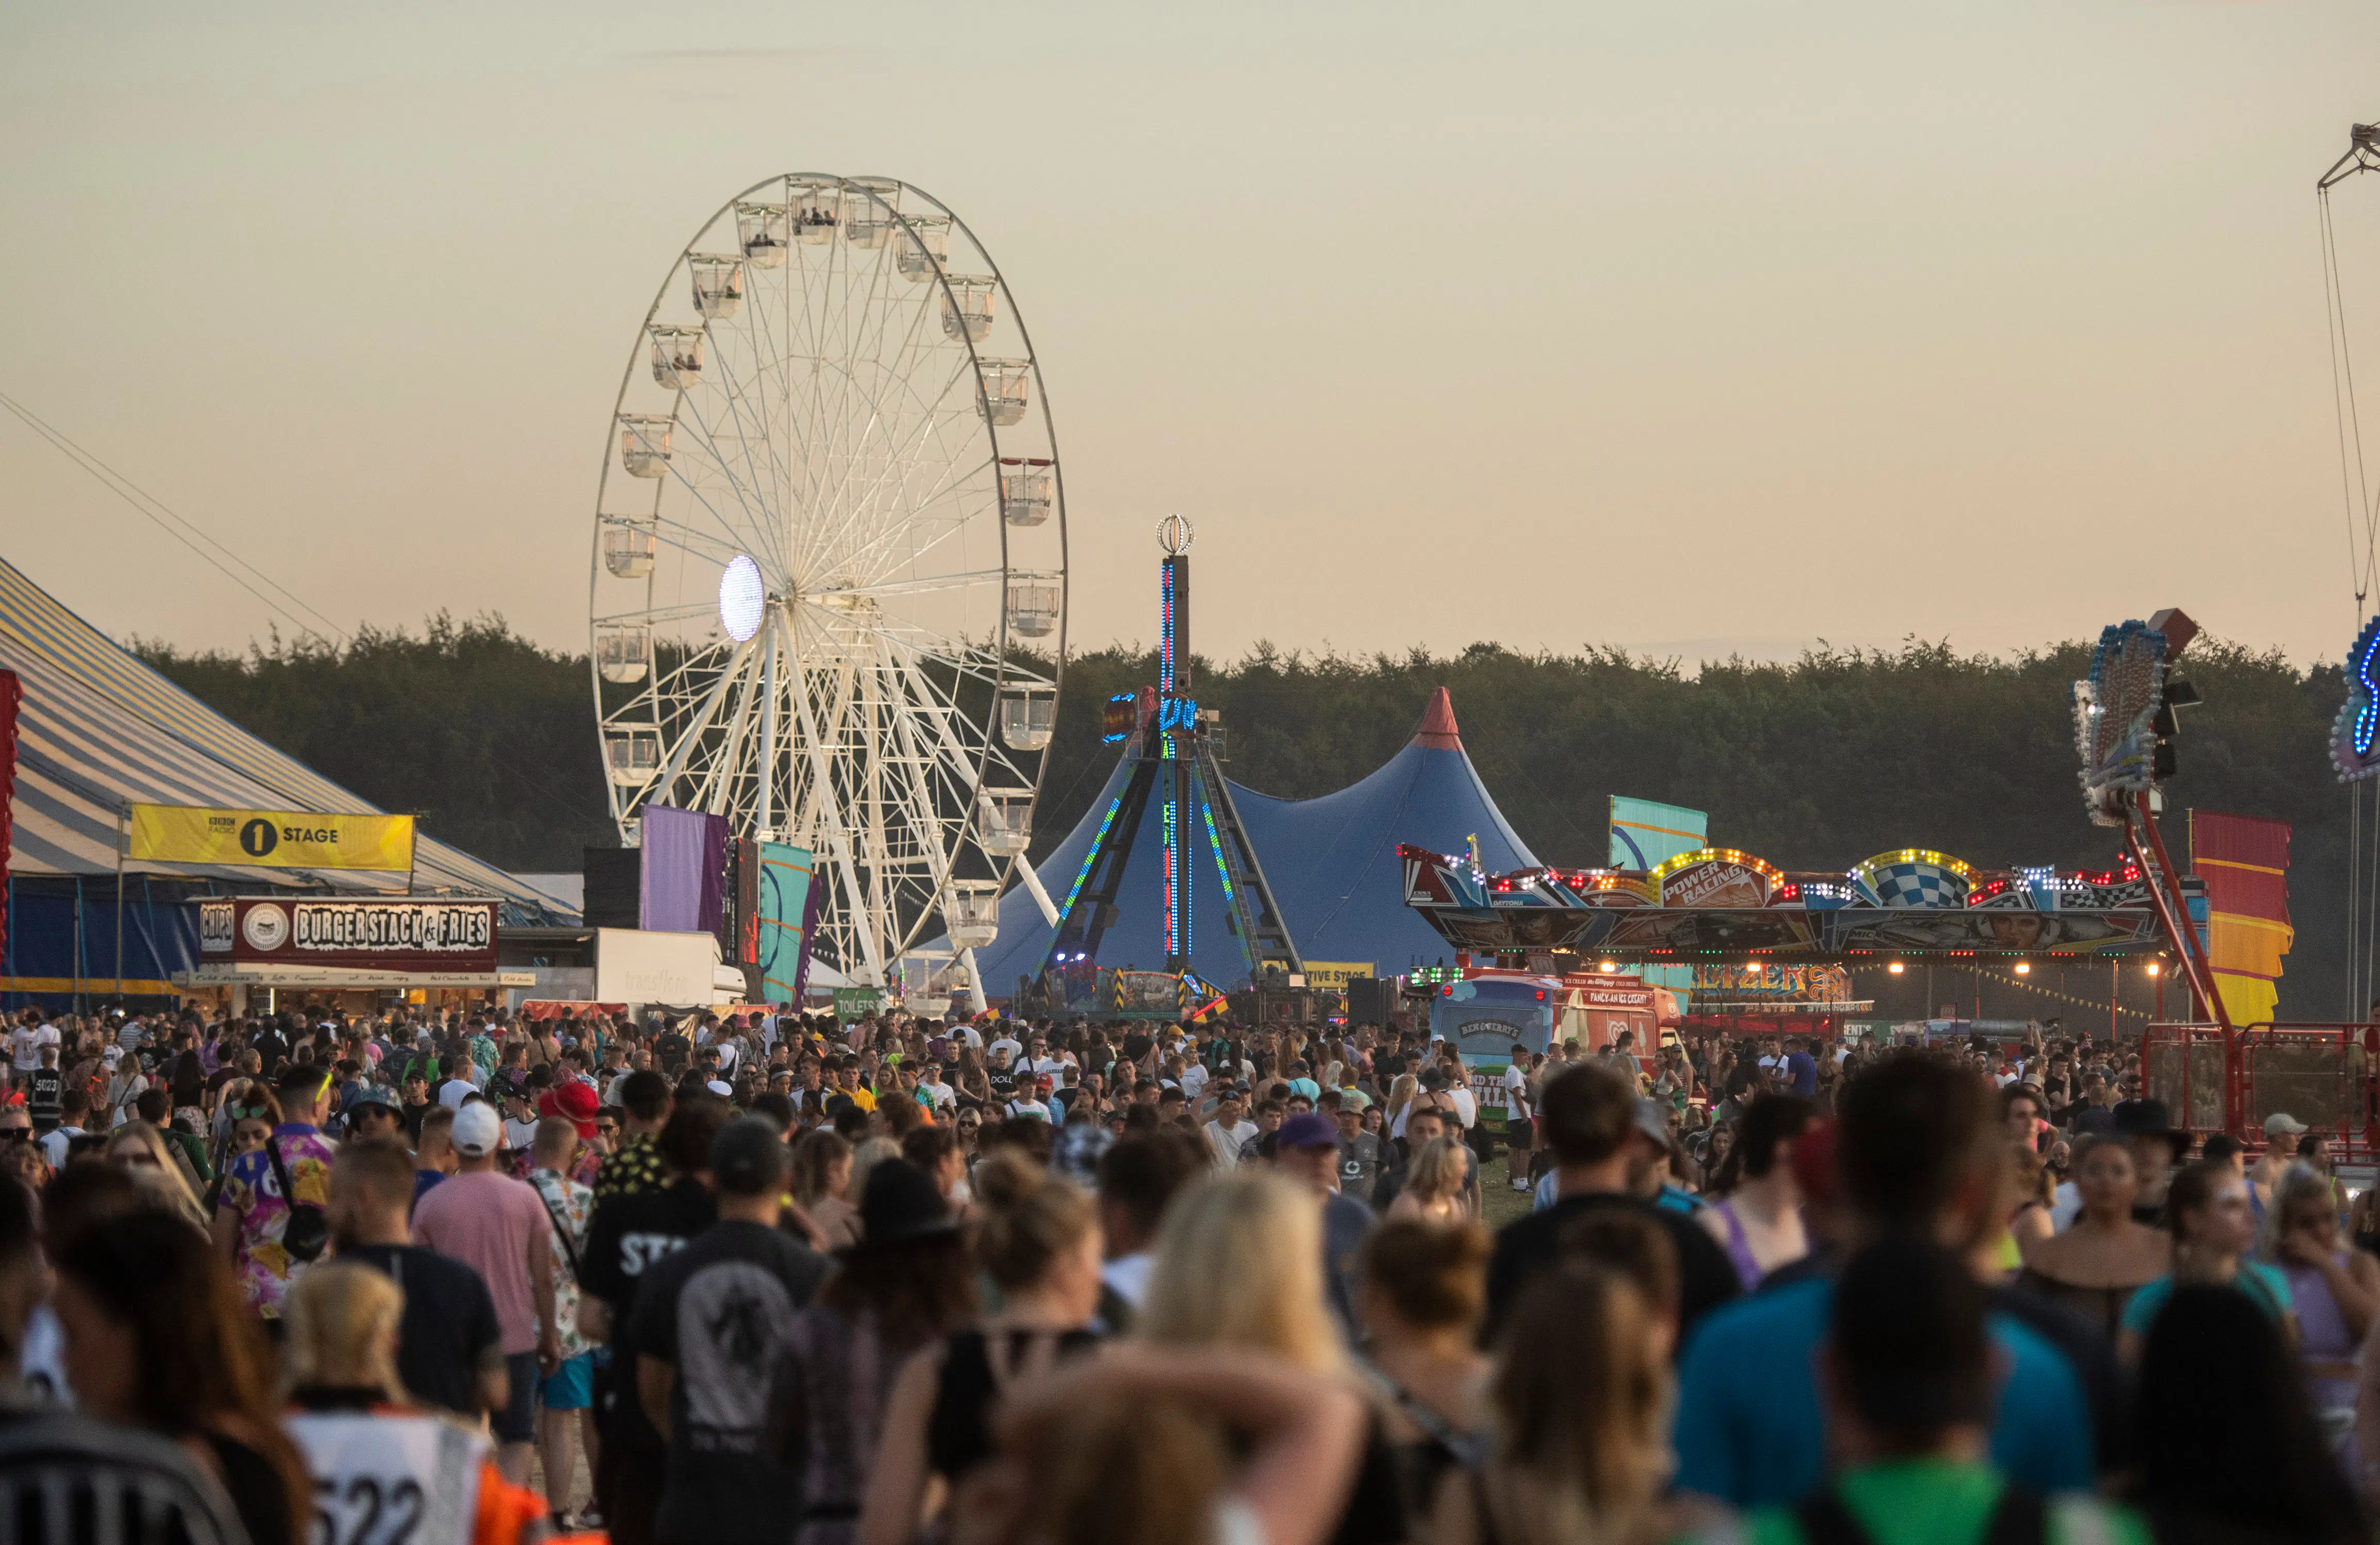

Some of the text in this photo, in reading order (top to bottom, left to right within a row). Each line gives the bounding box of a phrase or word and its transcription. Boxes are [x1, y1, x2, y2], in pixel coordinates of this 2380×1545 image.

[252, 824, 337, 852] 1 STAGE
[1663, 861, 1721, 901] POWER
[1682, 863, 1741, 904] RACING
[201, 908, 232, 940] CHIPS
[424, 915, 436, 942] &
[438, 909, 487, 947] FRIES
[1307, 970, 1330, 982] TIVE
[1595, 978, 1615, 987] Whippy
[1590, 992, 1609, 1003] FANCY
[1610, 993, 1618, 1003] AN
[1618, 994, 1627, 1004] ICE
[838, 999, 875, 1014] TOILETS
[36, 1080, 57, 1092] 5023
[991, 1075, 1012, 1084] DOLL
[1488, 1075, 1505, 1086] TH
[620, 1233, 687, 1275] ST
